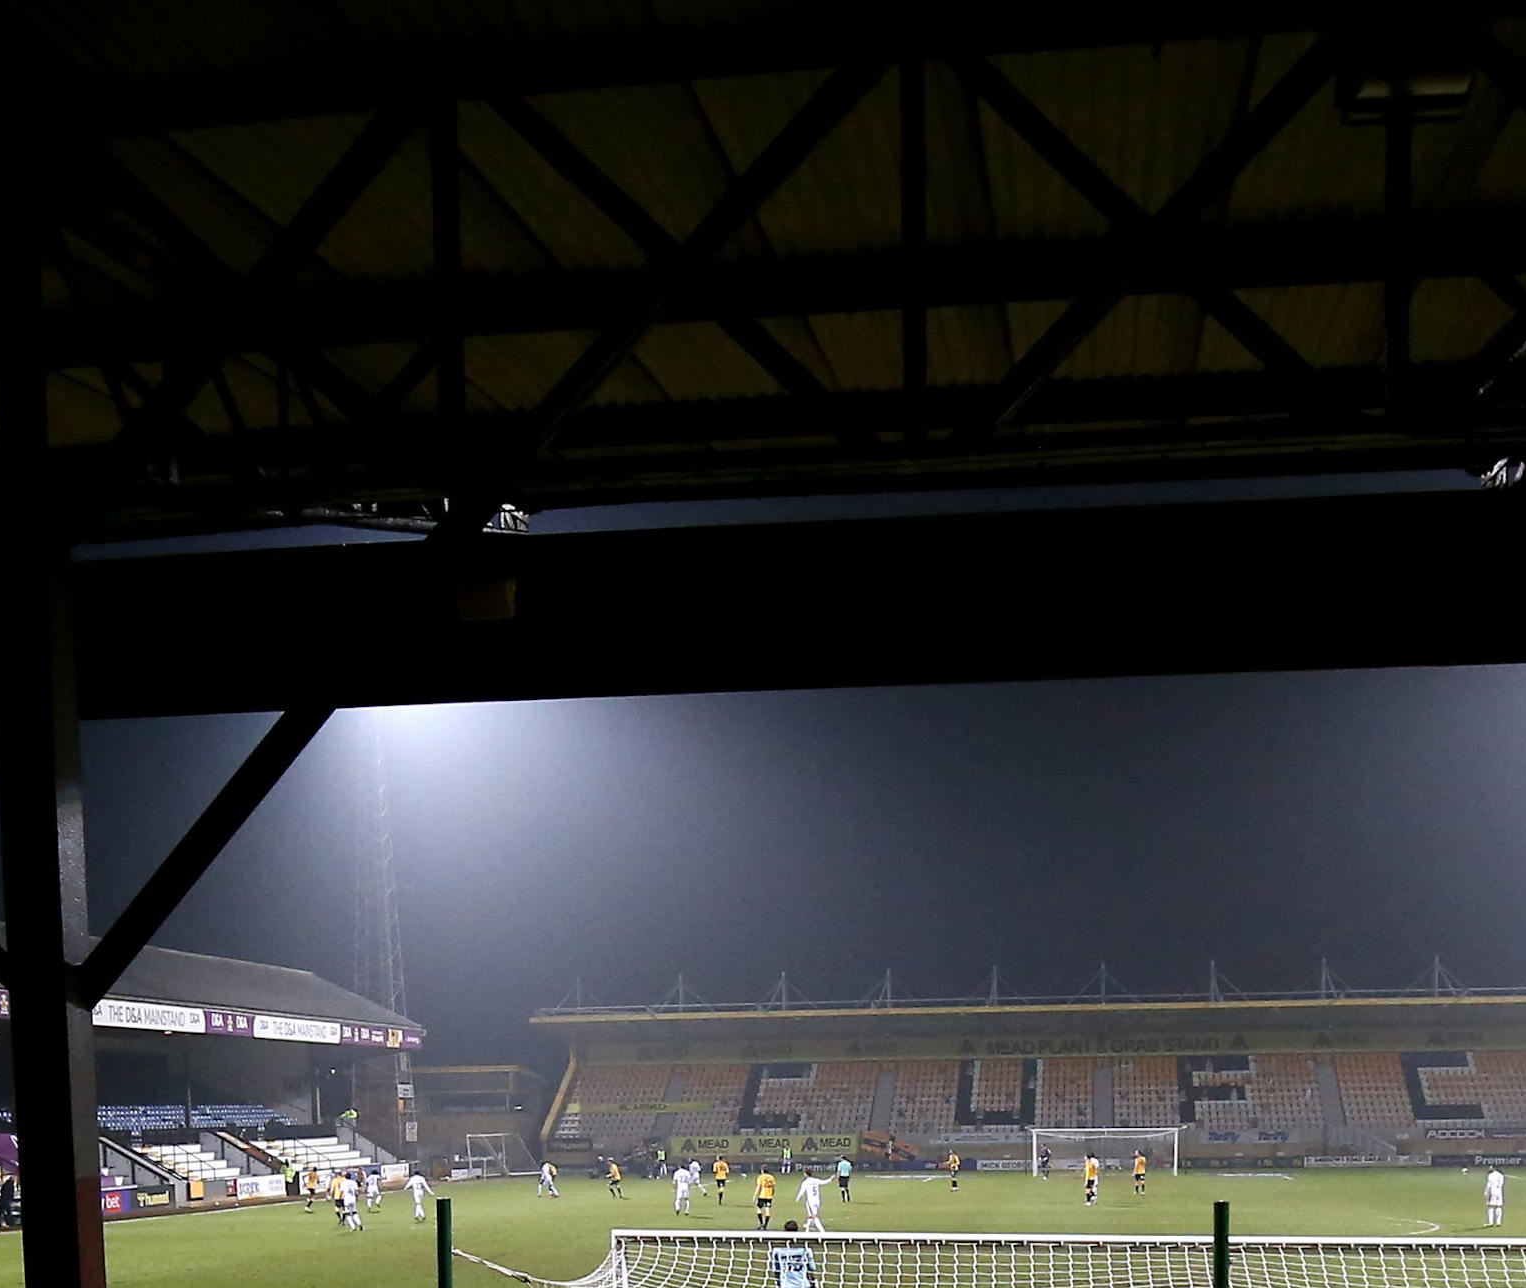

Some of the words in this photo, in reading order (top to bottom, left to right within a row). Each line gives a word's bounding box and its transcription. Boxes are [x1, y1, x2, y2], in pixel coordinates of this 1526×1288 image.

[108, 1005, 124, 1023] THE
[125, 1007, 142, 1024] D&A
[144, 1008, 185, 1028] MAINSTAND
[211, 1012, 224, 1028] D&A
[236, 1014, 249, 1030] D&A
[1163, 1037, 1220, 1052] STAND
[698, 1138, 729, 1149] MEAD
[759, 1138, 790, 1148] MEAD
[820, 1137, 851, 1148] MEAD
[1475, 1155, 1522, 1166] Premier
[106, 1193, 121, 1209] bet
